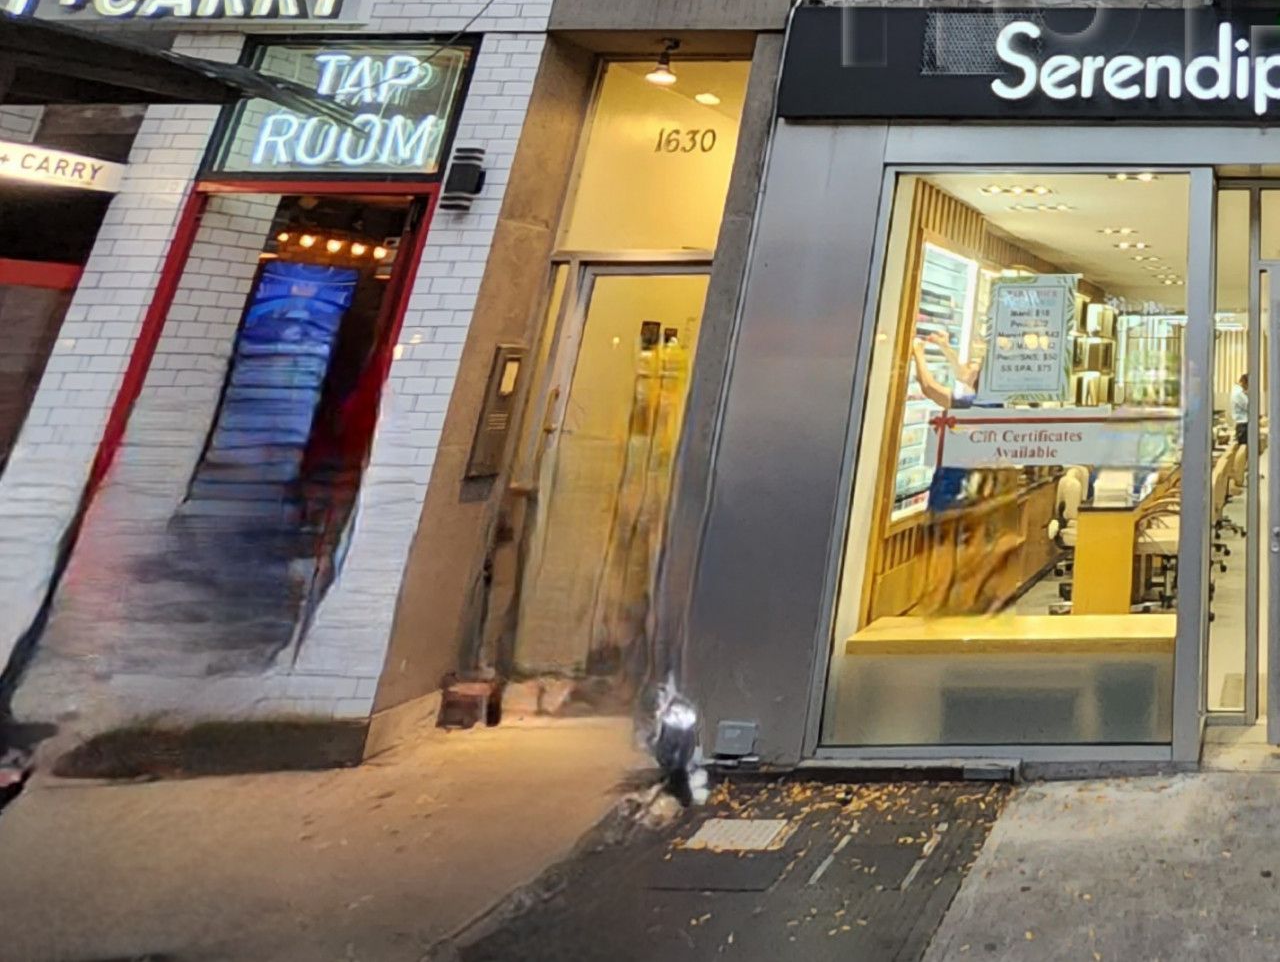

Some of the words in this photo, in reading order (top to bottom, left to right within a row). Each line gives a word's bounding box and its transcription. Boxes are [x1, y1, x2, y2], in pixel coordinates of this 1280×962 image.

[315, 54, 421, 103] TAP
[252, 112, 440, 166] ROOM
[654, 127, 717, 153] 1630
[20, 152, 104, 182] CARRY
[1001, 429, 1083, 443] Certificates
[993, 445, 1059, 459] Available
